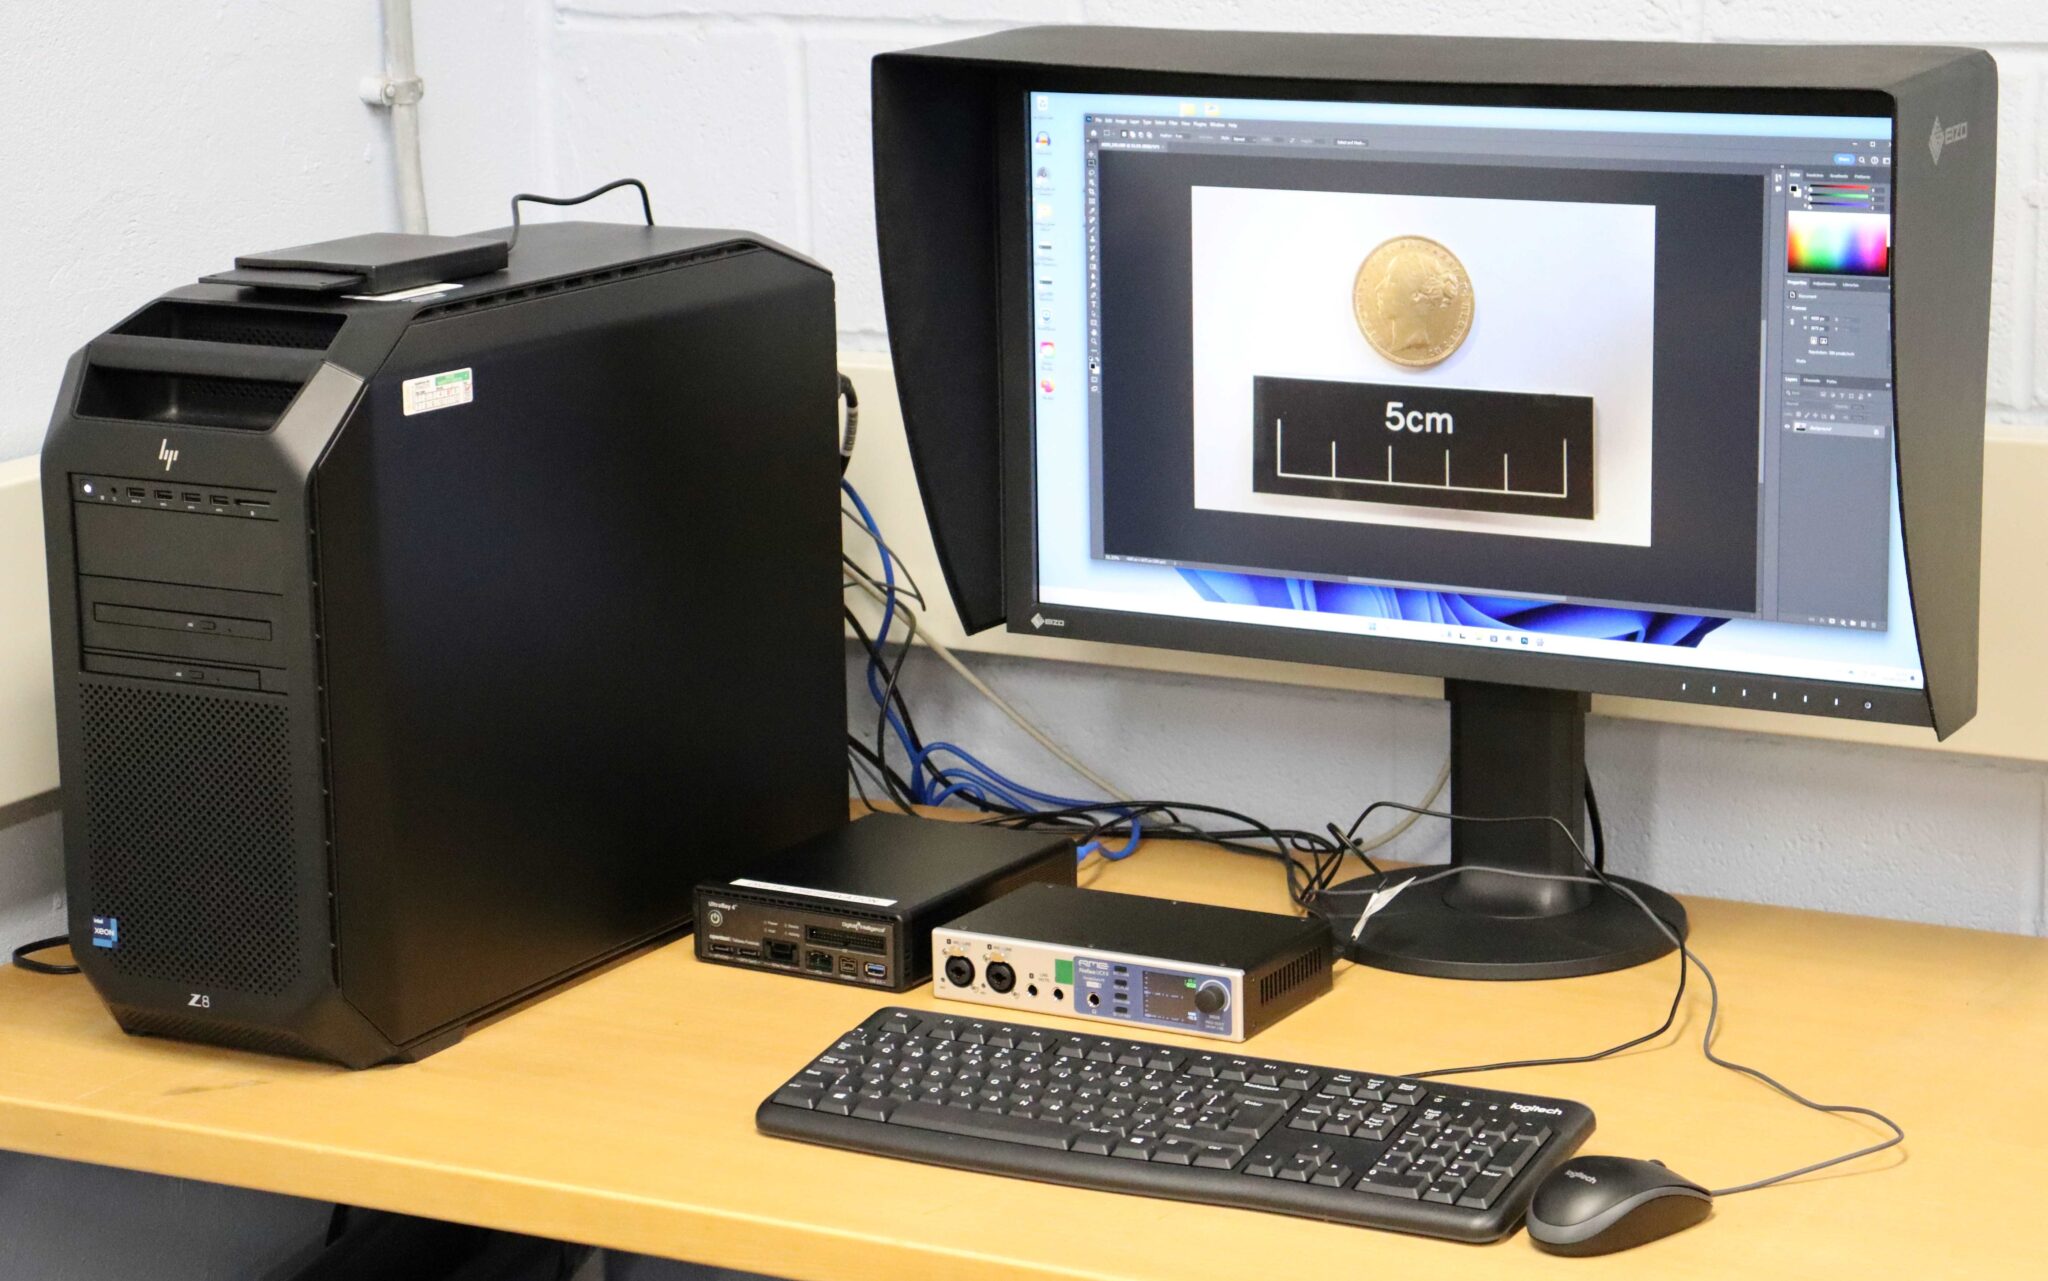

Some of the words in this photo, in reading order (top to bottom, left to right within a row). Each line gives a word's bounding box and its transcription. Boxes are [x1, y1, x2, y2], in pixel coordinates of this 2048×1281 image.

[1945, 121, 1968, 145] EIZO
[1385, 401, 1454, 434] 5cm
[158, 438, 180, 472] hp
[1044, 618, 1065, 627] EIZO
[188, 993, 210, 1008] Z8
[1510, 1102, 1563, 1116] logitech
[1565, 1169, 1597, 1185] logitech
